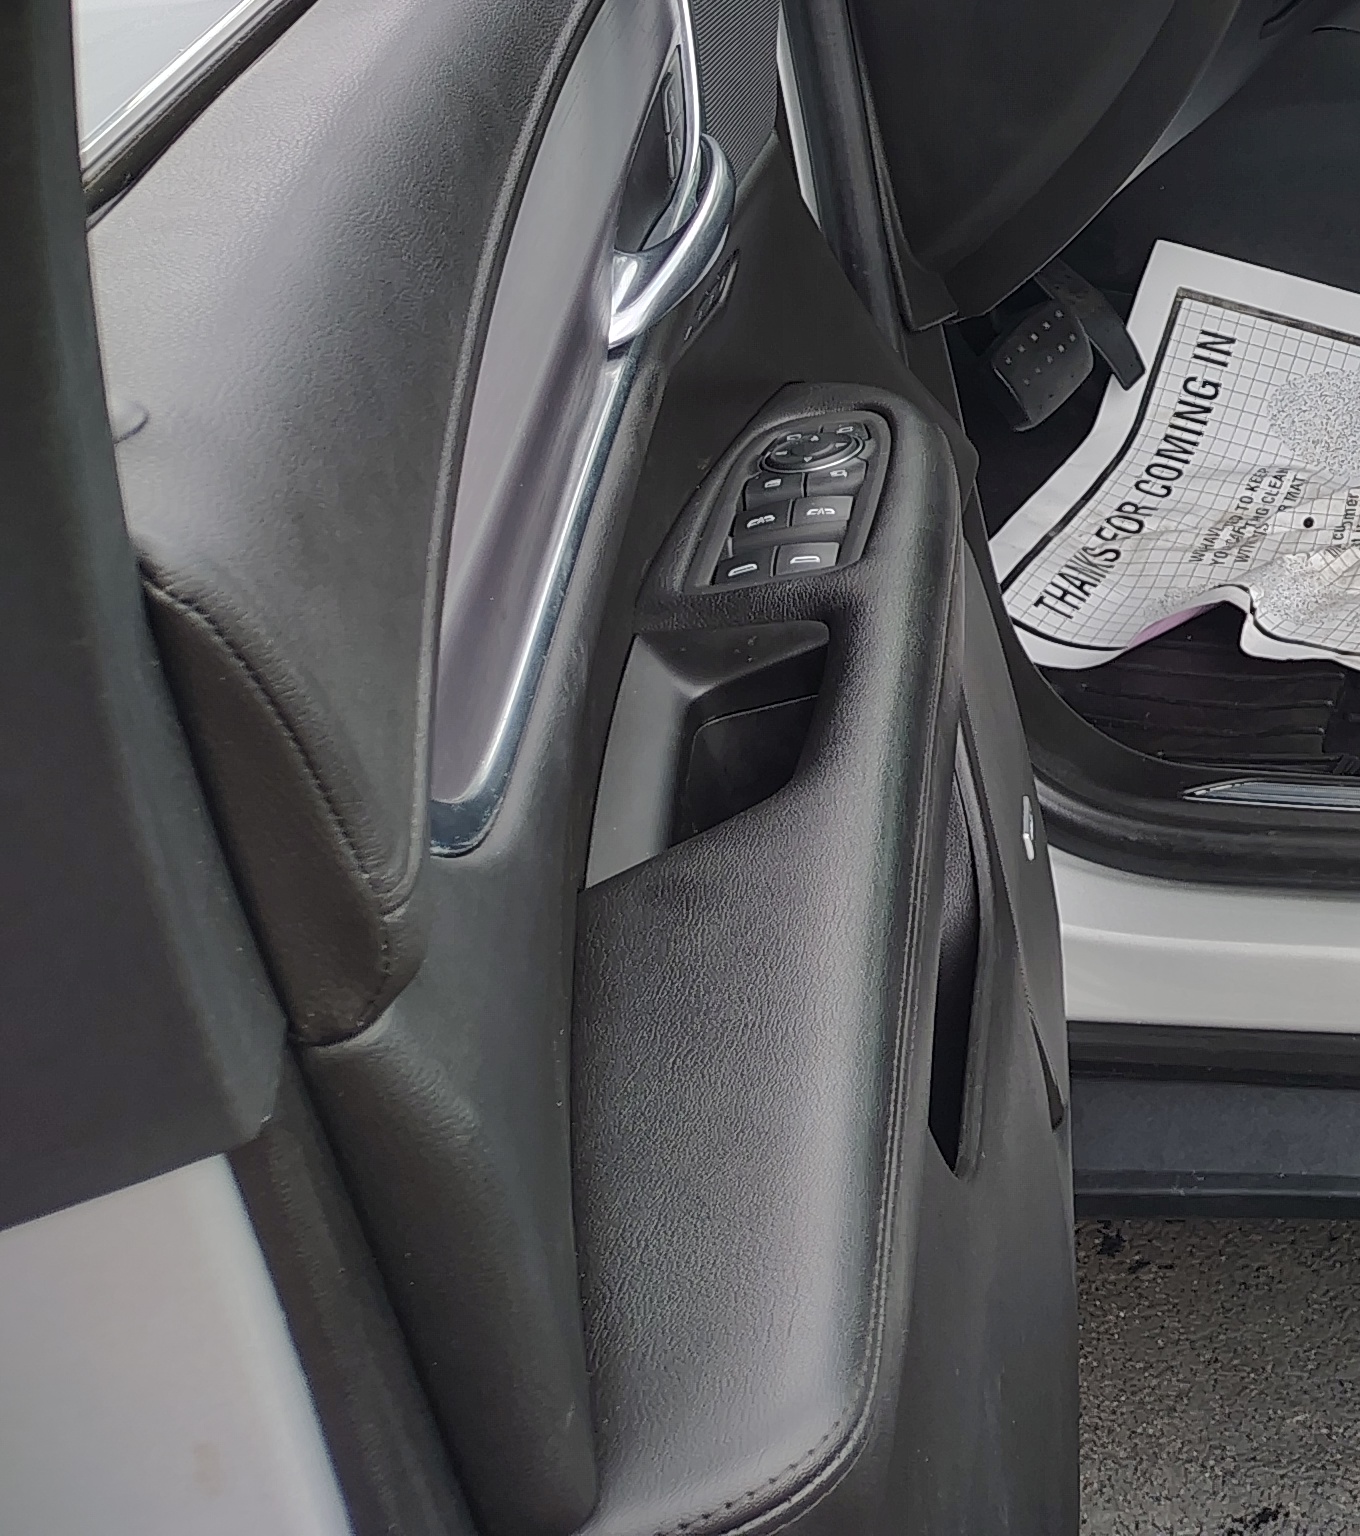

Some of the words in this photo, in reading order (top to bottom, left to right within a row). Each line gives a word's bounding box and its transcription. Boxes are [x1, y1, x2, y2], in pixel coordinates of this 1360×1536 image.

[1033, 545, 1121, 619] THANKS
[1095, 501, 1158, 542] FOR
[1134, 376, 1222, 499] COMING
[1192, 329, 1236, 368] IN
[1235, 495, 1254, 512] TO
